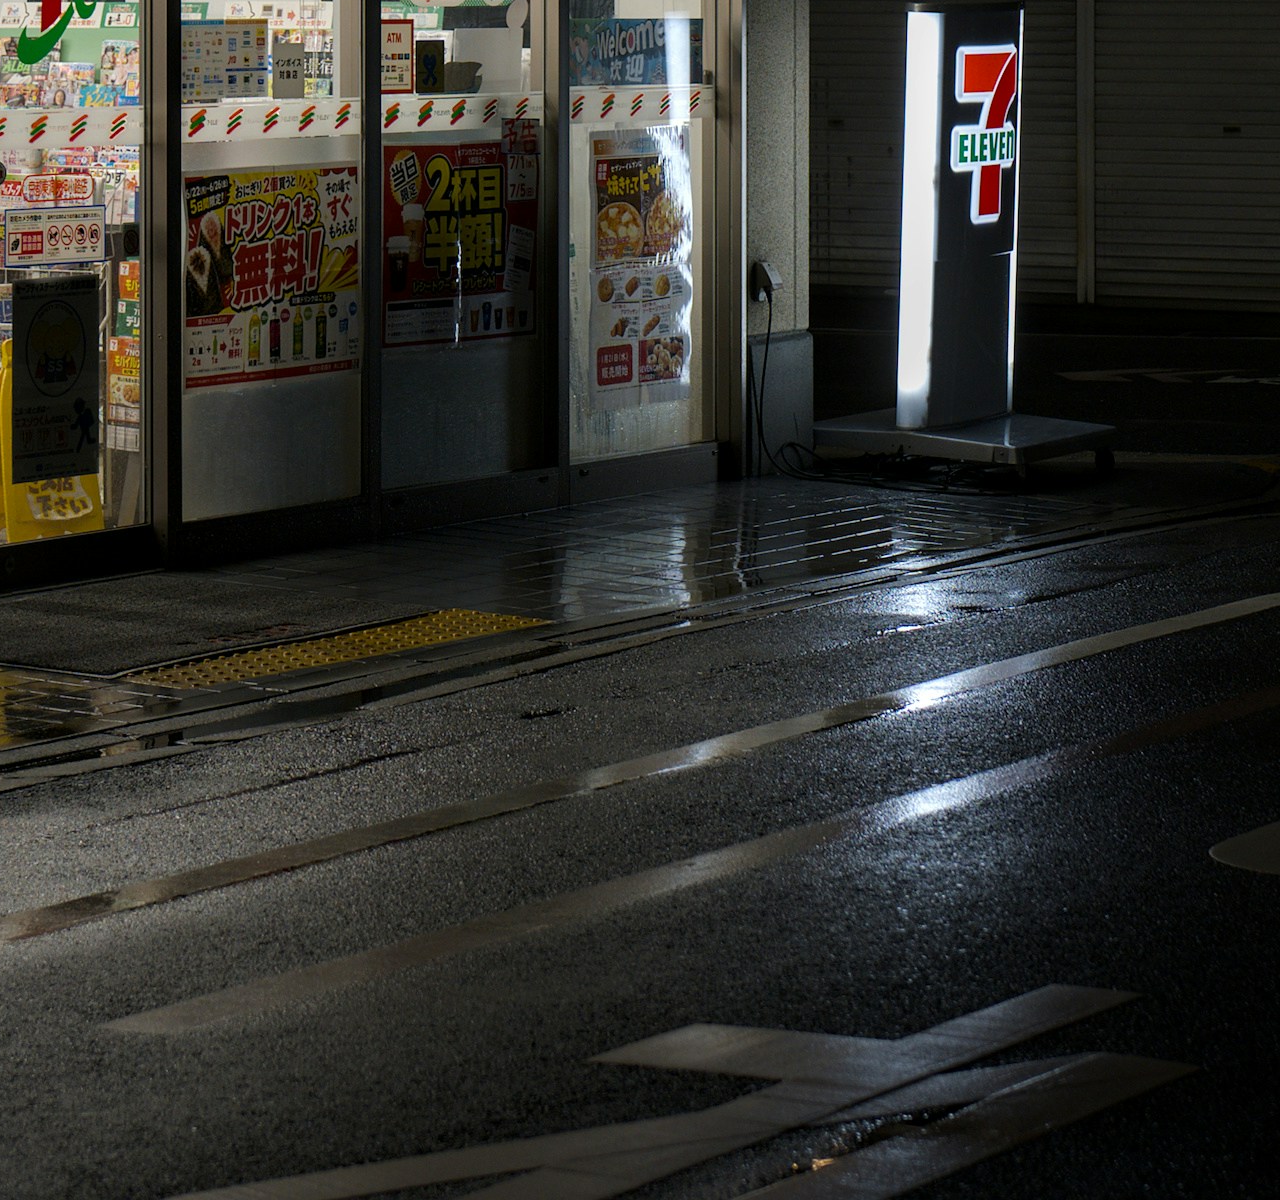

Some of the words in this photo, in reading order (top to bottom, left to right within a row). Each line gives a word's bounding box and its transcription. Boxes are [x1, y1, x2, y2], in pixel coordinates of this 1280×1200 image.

[386, 32, 402, 43] ATM
[597, 19, 665, 60] Welcome
[2, 61, 30, 73] ALBA
[280, 70, 298, 79] 対象店
[391, 154, 418, 188] 当日
[424, 154, 501, 212] 2杯目
[326, 179, 350, 195] その場で
[225, 194, 317, 244] ドリンク1本
[327, 193, 352, 221] すぐ
[329, 217, 358, 238] もらえる!
[232, 227, 324, 309] 無料!
